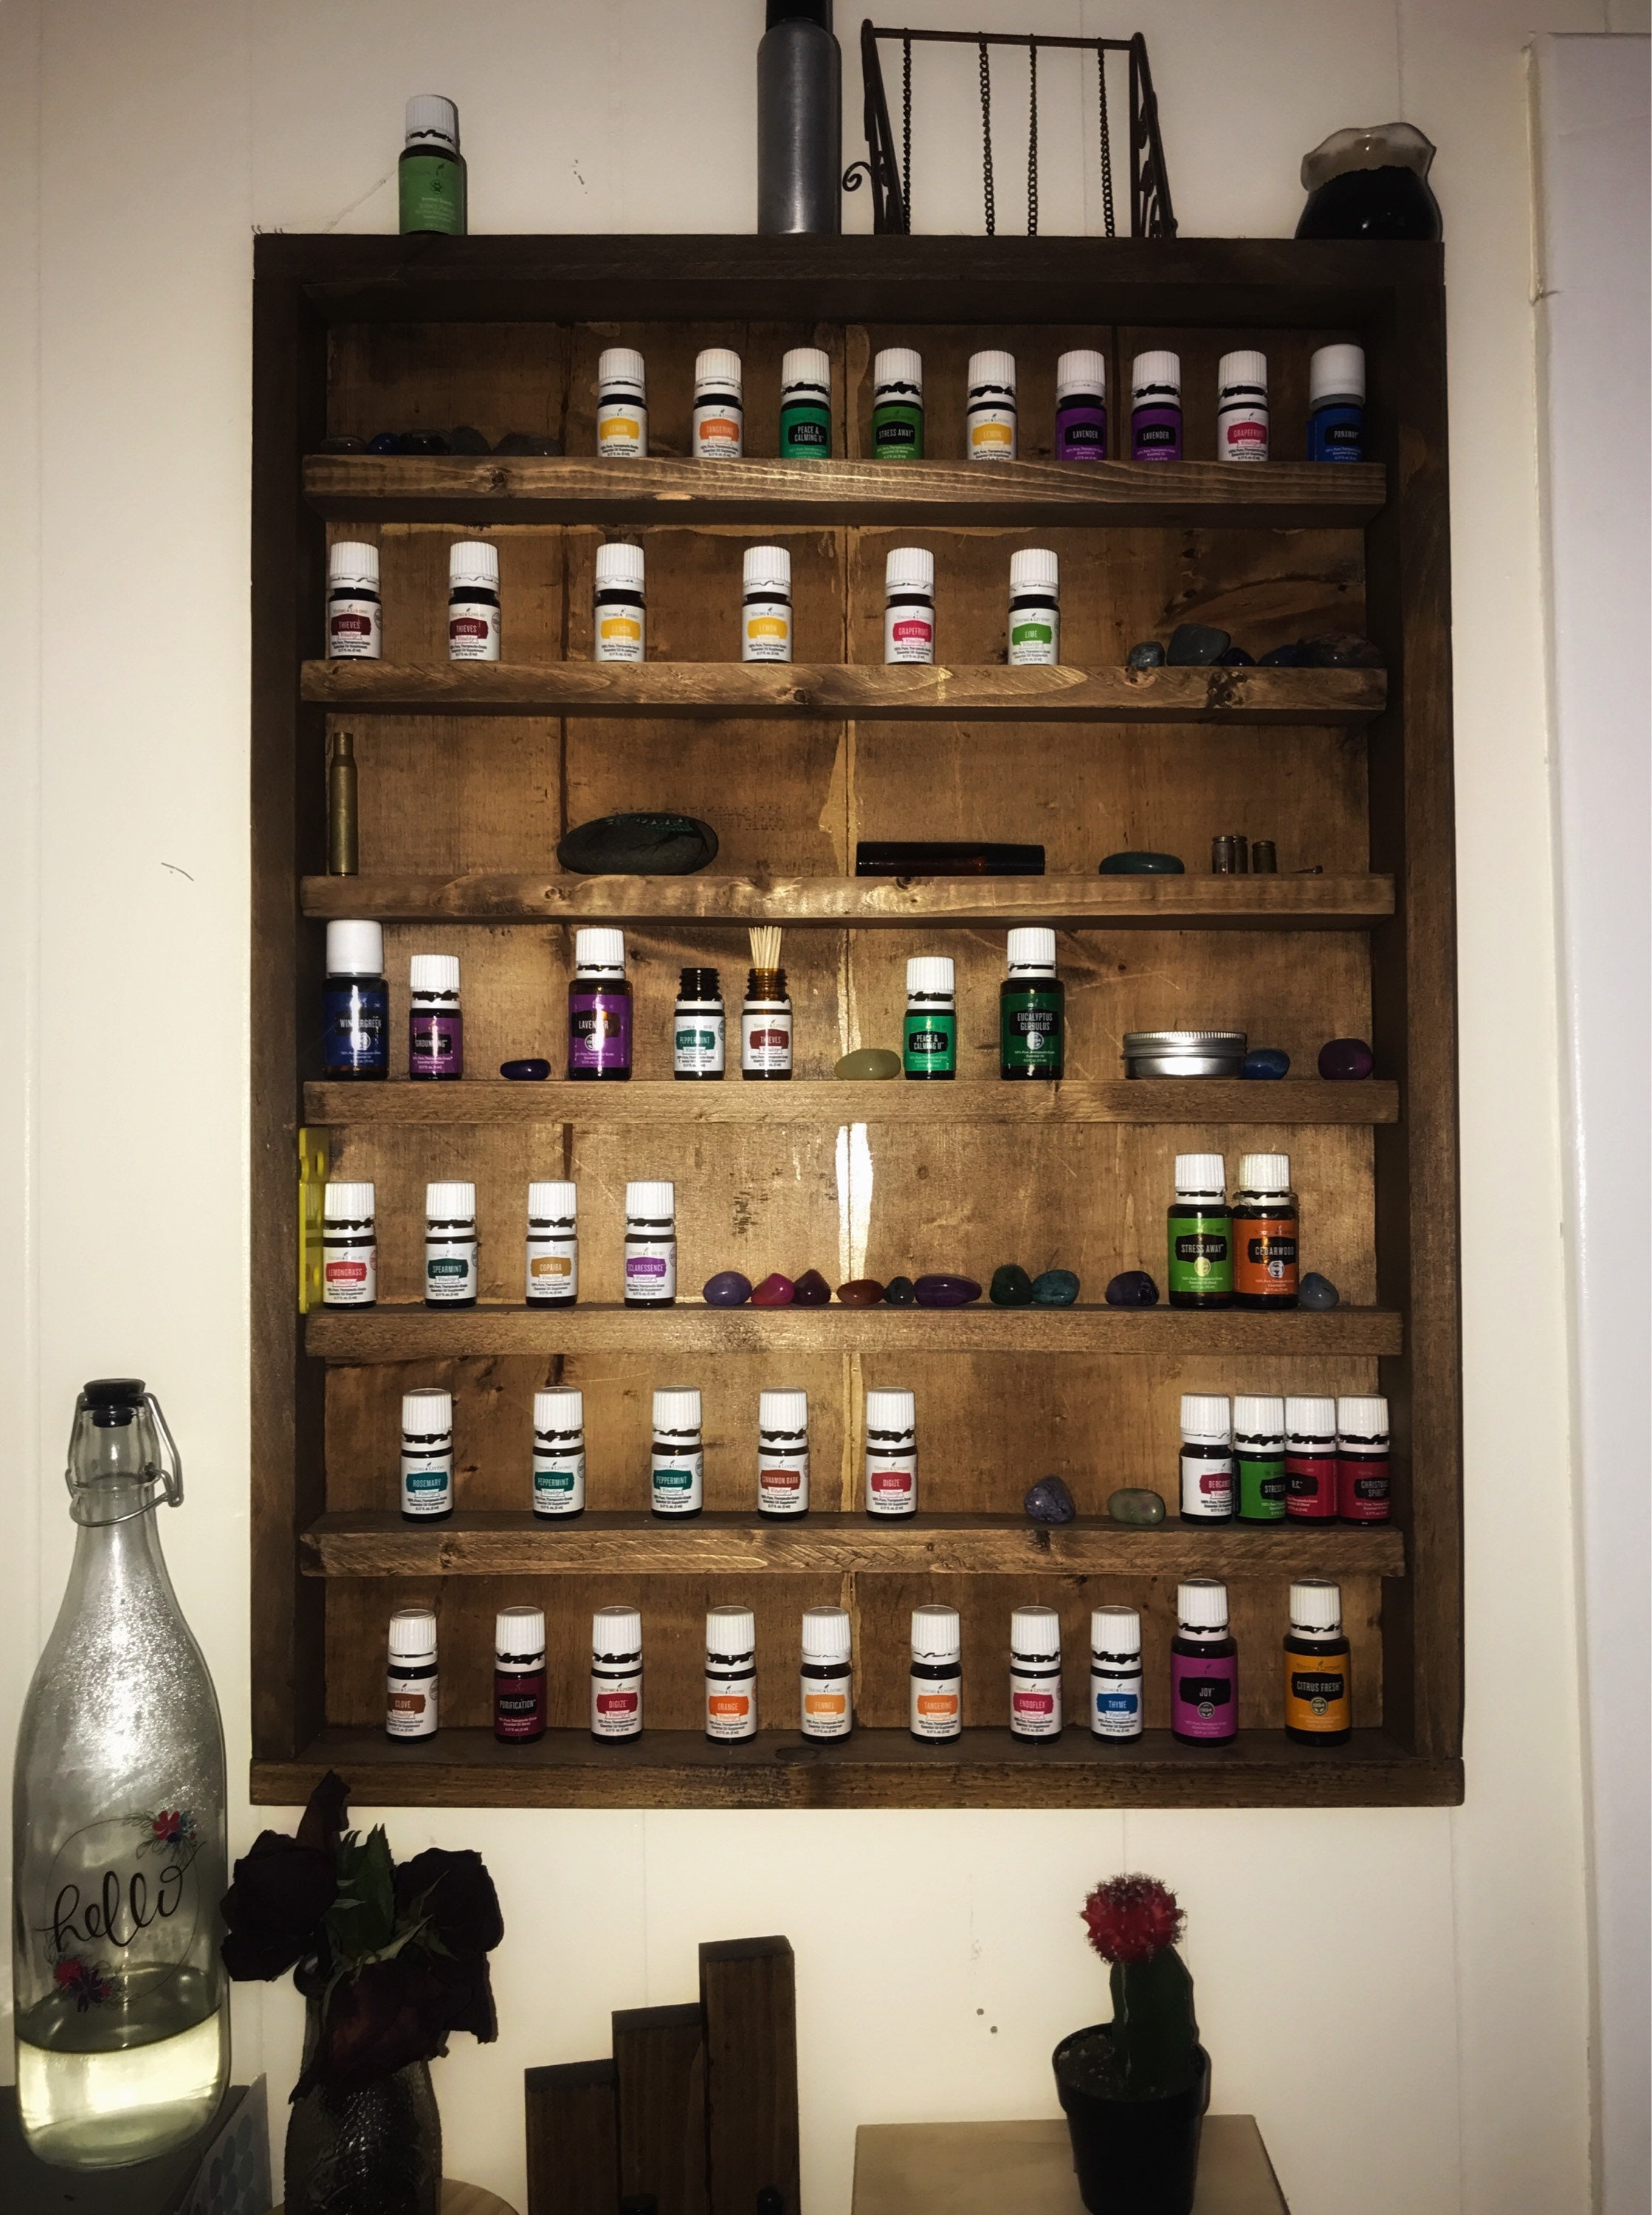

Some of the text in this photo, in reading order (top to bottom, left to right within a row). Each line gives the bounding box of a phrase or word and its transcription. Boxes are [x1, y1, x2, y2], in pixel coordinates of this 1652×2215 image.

[797, 425, 814, 434] PEACE
[878, 428, 912, 439] STRESS AWAY
[794, 433, 818, 442] CALMING
[1073, 430, 1098, 439] LAVENDER
[1143, 430, 1169, 441] LAVENDER
[338, 620, 360, 629] THIEVES
[456, 625, 477, 633] THIEVES
[898, 627, 929, 636] GRAPEFRUIT
[1025, 630, 1038, 639] LIME
[1017, 1012, 1053, 1022] EUCALYPTUS
[340, 1019, 382, 1028] WINRGREEN
[579, 1020, 608, 1029] LAVENR
[679, 1036, 710, 1044] PEPPERINT
[760, 1036, 782, 1044] THEVES
[916, 1034, 938, 1043] PEACE &
[1181, 1244, 1222, 1254] STRESS AWAY
[433, 1265, 462, 1274] SPEARMINT
[540, 1263, 562, 1272] COPAIBA
[328, 1268, 362, 1277] LEMONGRASS
[413, 1478, 441, 1488] ROSEMARY
[537, 1477, 569, 1486] PEPPERMINT
[656, 1475, 687, 1485] PEPPERMINT
[762, 1476, 799, 1485] CINNAMON BARK
[883, 1479, 901, 1487] DIGIZE
[1297, 1680, 1340, 1692] CITRUS FRESH
[1199, 1687, 1212, 1697] JOY
[395, 1700, 411, 1709] CLOVE
[499, 1700, 534, 1709] PURIFICATION
[609, 1700, 627, 1709] DIGIZE
[717, 1702, 738, 1711] ORANGE
[814, 1701, 834, 1709] FENNEL
[924, 1701, 952, 1710] TANGERINE
[1019, 1700, 1046, 1709] ENDOFLEX
[1108, 1700, 1127, 1709] THYME
[37, 1843, 206, 1952] hello
